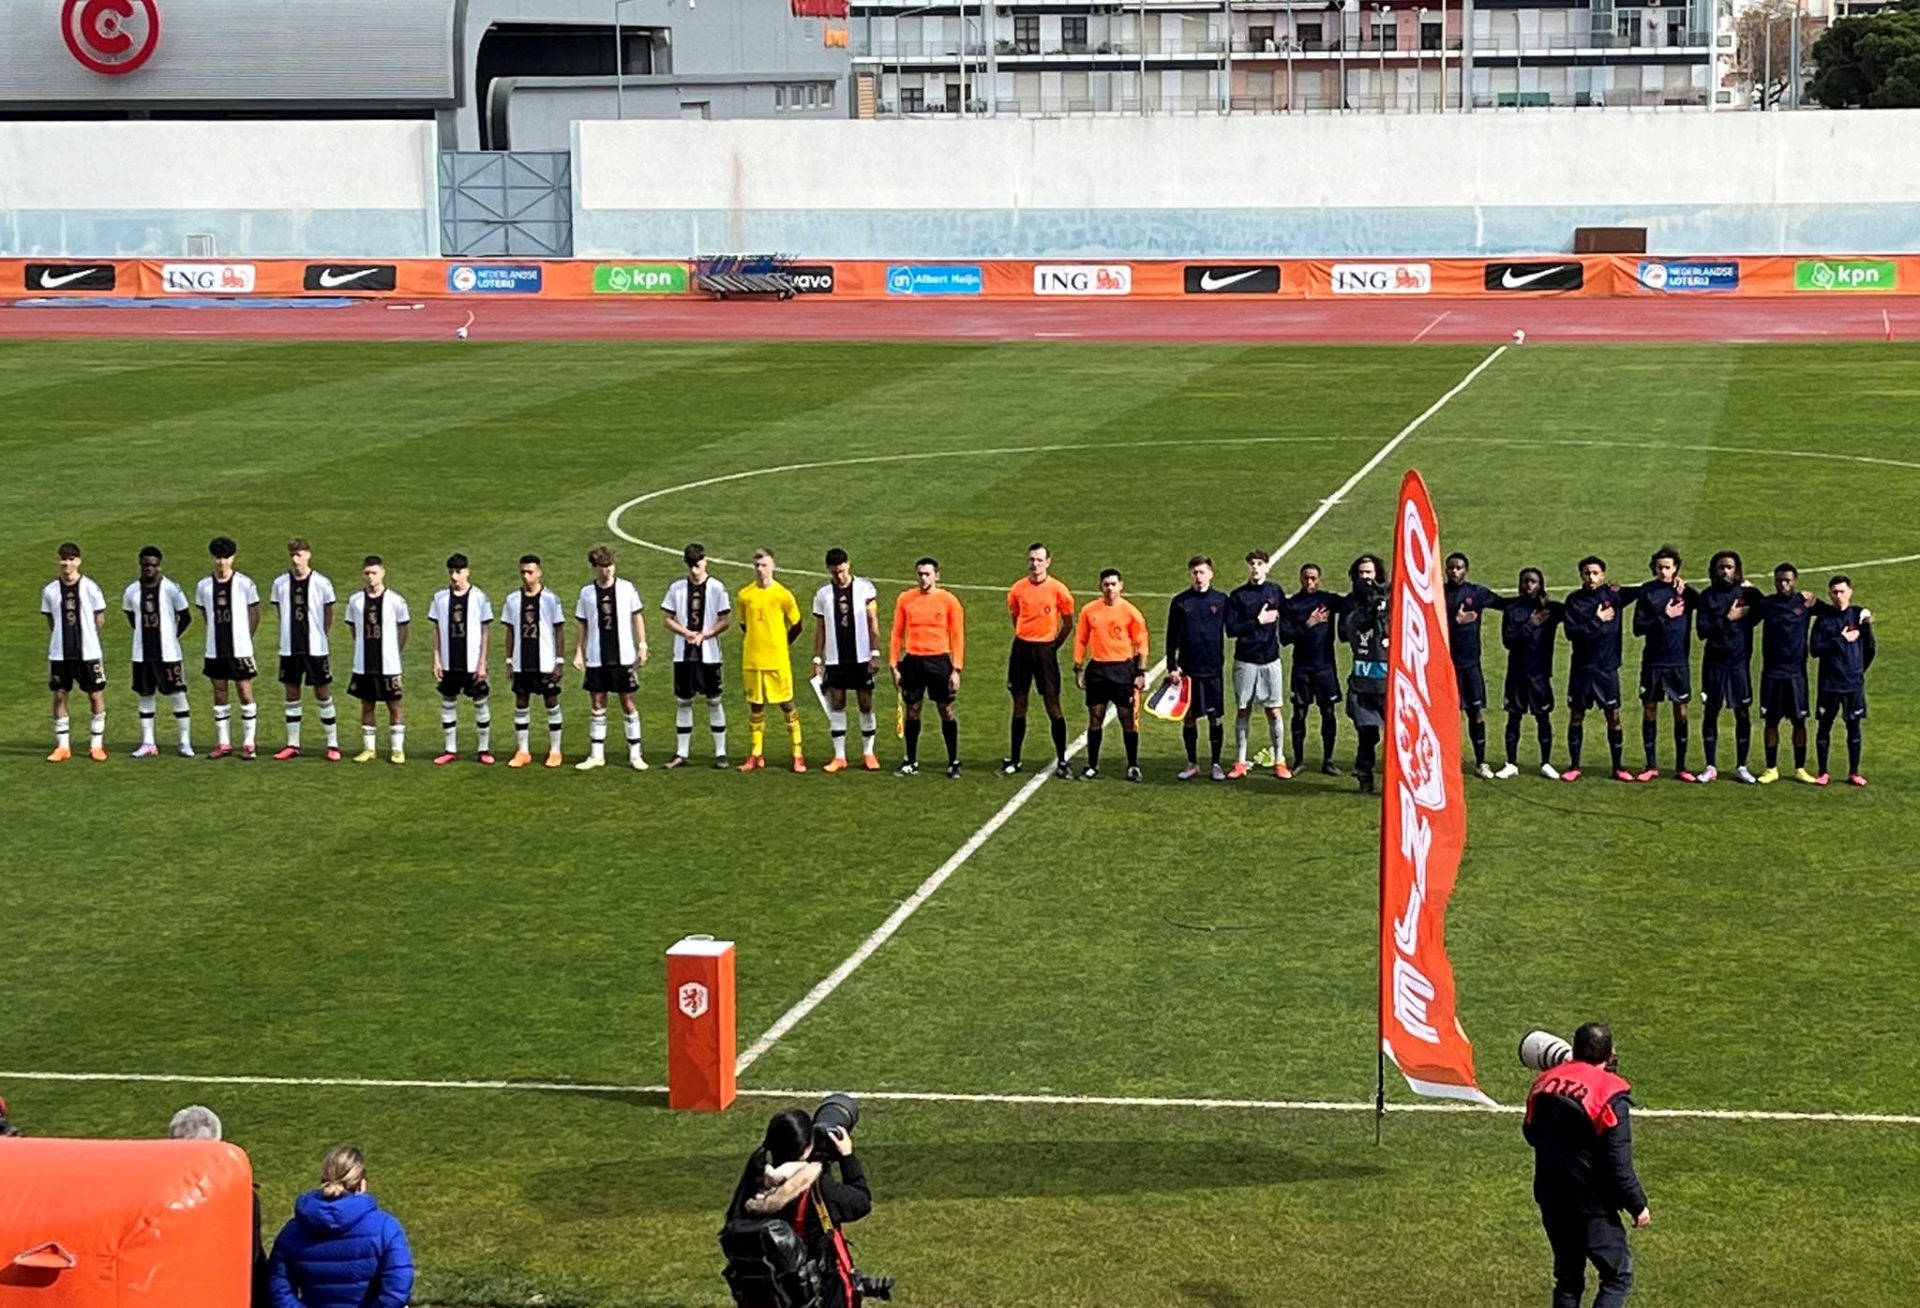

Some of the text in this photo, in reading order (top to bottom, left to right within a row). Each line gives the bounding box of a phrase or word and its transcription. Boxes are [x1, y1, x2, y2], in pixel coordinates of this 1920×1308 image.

[168, 271, 215, 289] ING
[633, 269, 672, 289] kpn
[1041, 272, 1088, 290] ING
[1339, 271, 1387, 289] ING
[1838, 265, 1879, 287] kpn
[67, 611, 76, 627] 9
[143, 613, 159, 628] 19
[604, 615, 612, 630] 2
[366, 624, 381, 640] 18
[522, 623, 538, 639] 22
